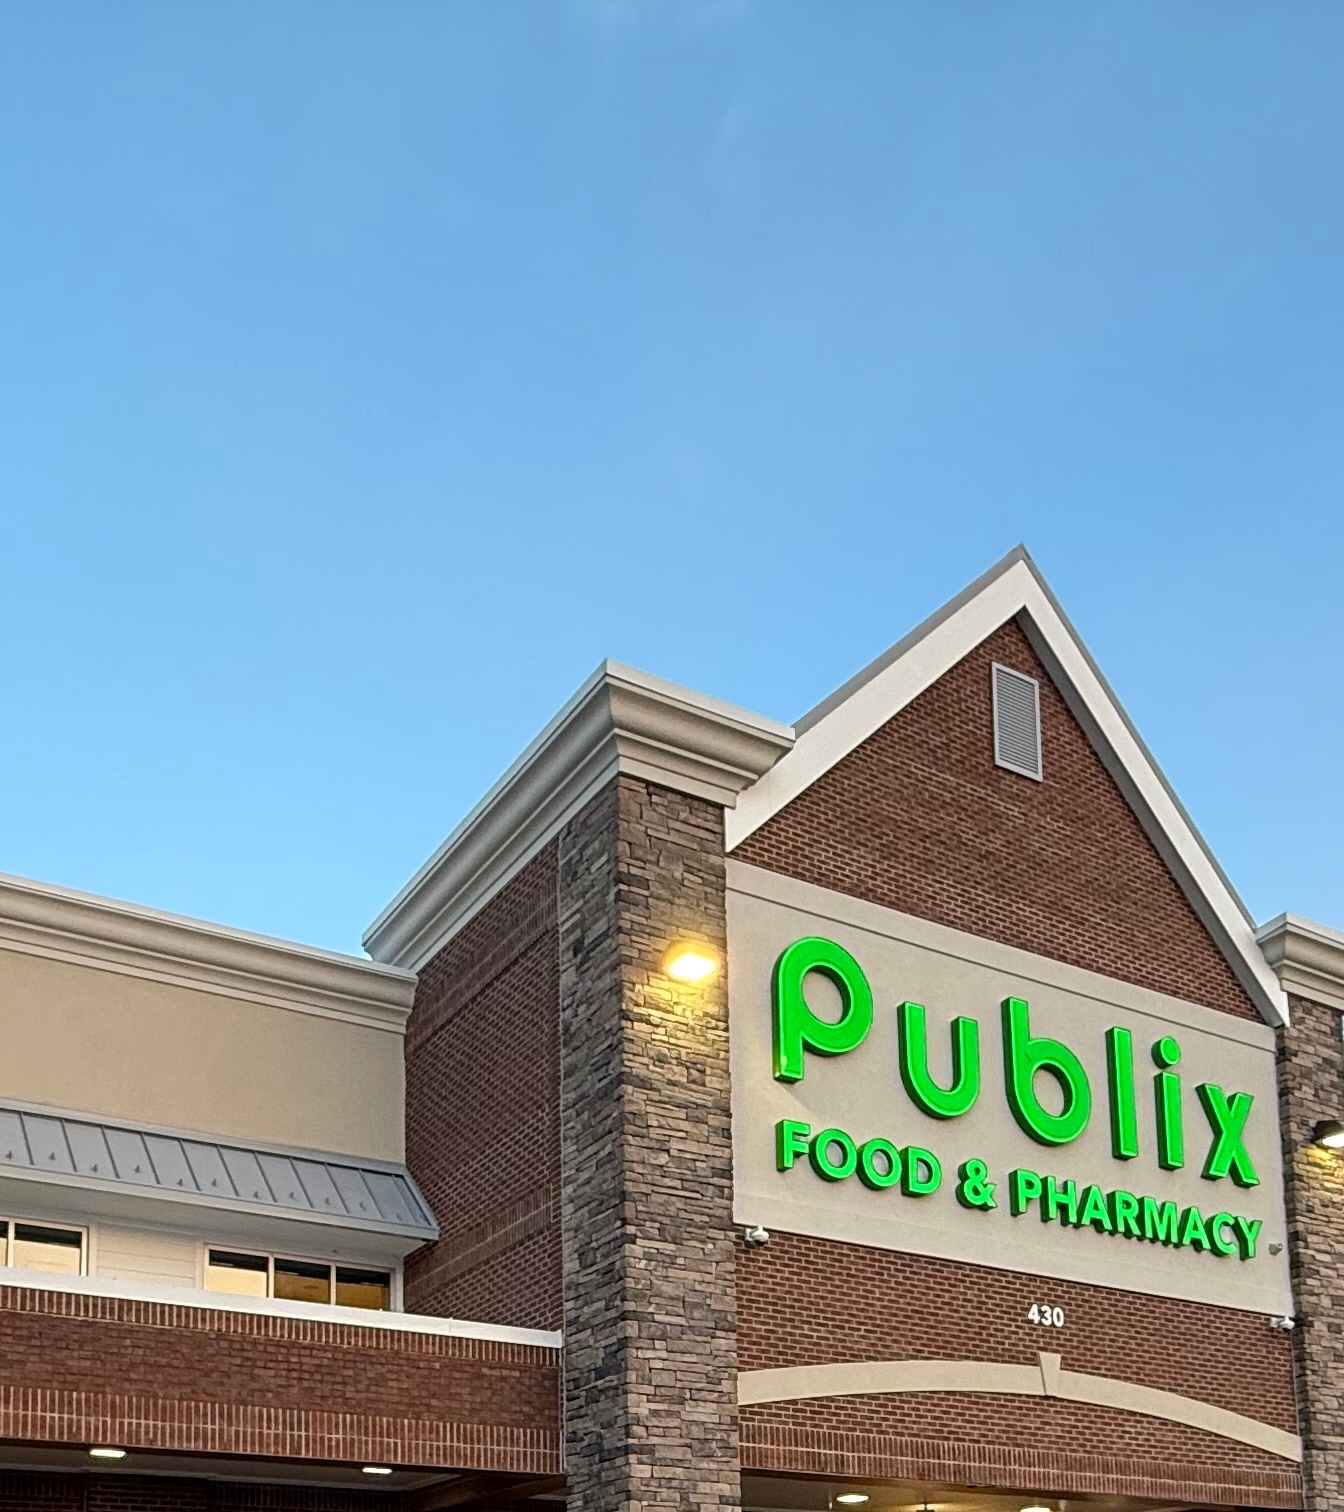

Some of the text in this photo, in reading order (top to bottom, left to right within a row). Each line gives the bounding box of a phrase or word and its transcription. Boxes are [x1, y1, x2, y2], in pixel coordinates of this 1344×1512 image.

[771, 936, 1260, 1188] Publix
[775, 1118, 1263, 1261] FOOD & PHARMACY
[1027, 1303, 1065, 1328] 430
